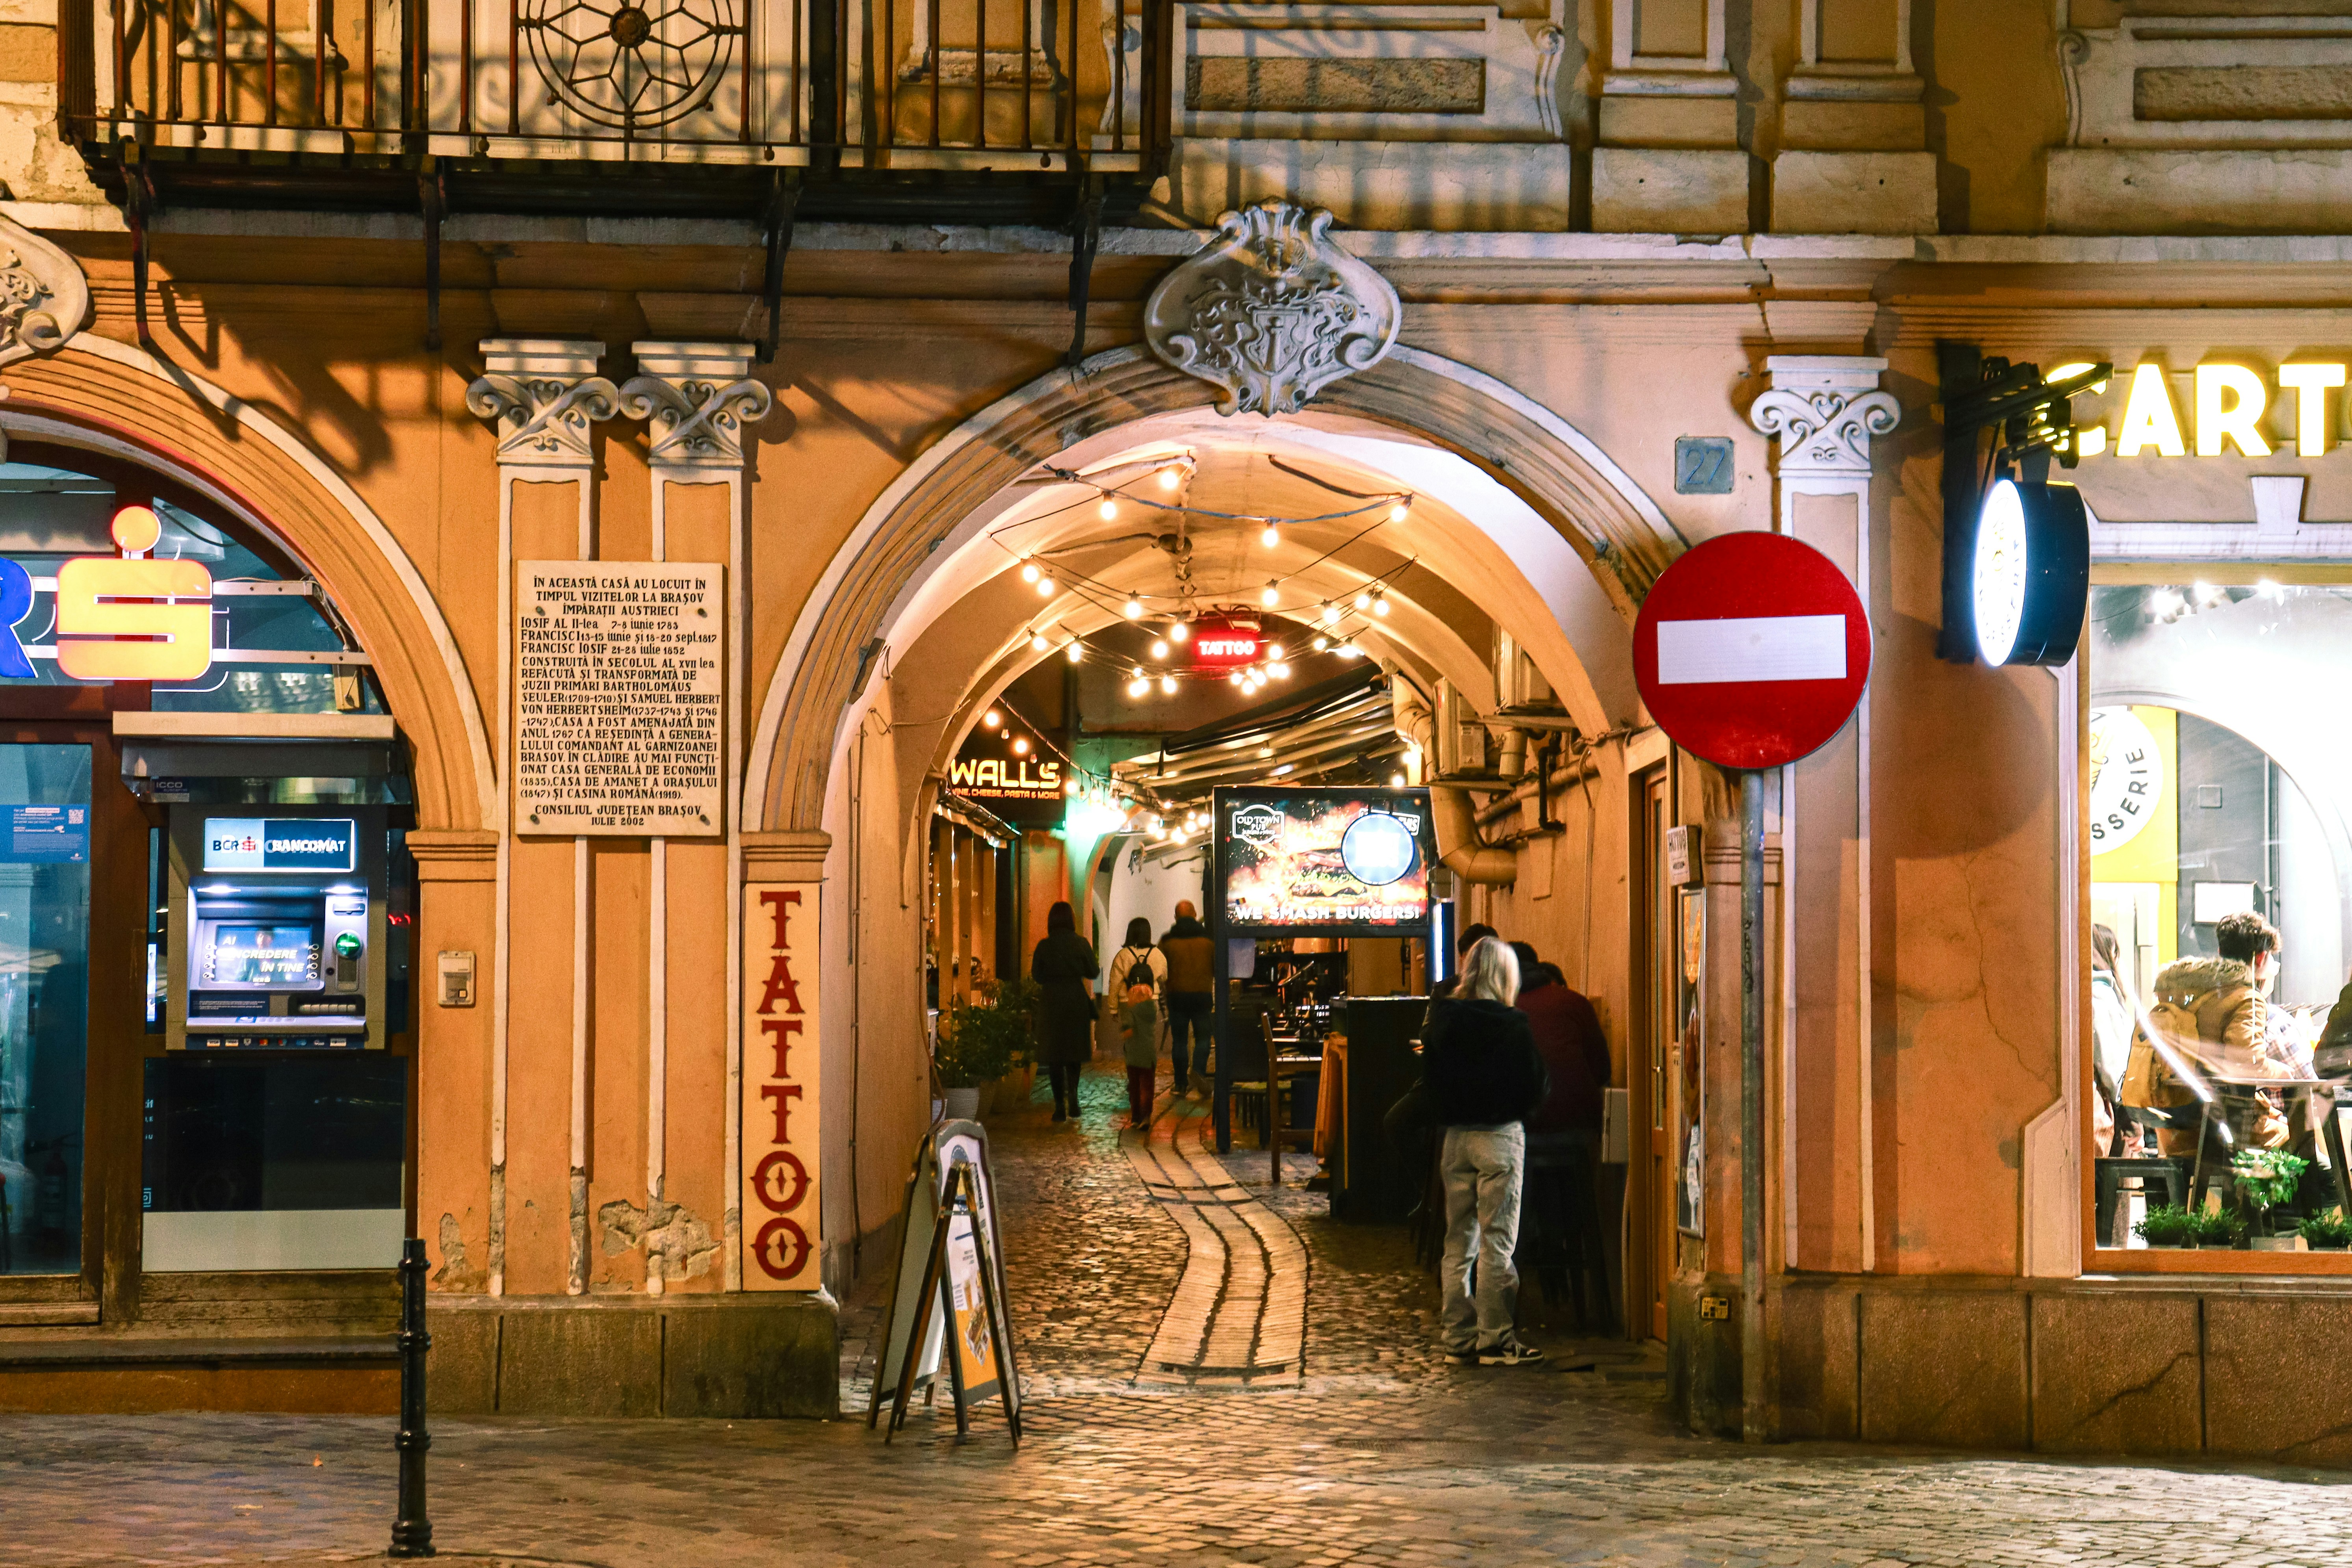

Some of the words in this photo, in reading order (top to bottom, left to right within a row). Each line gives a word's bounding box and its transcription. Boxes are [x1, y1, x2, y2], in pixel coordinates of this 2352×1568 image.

[1686, 446, 1725, 485] 27
[534, 575, 545, 588] ÎN
[634, 579, 648, 589] AU
[652, 579, 691, 590] LOCUIT
[695, 577, 706, 590] ÎN
[536, 591, 577, 601] TIMPUL
[581, 591, 639, 602] VIZITELOR
[642, 592, 657, 603] LA
[621, 605, 679, 616] AUSTRIECI
[521, 616, 549, 628] IOSIF
[553, 618, 568, 629] AL
[572, 618, 599, 629] II-lea
[611, 621, 627, 629] 7-8
[630, 618, 654, 630] iunie
[657, 621, 678, 630] 1783
[607, 630, 631, 642] iunie
[646, 634, 672, 645] 18-20
[579, 642, 607, 654] IOSIF
[611, 646, 636, 654] 21-28
[640, 643, 661, 655] iulie
[663, 646, 685, 655] 1852
[1199, 640, 1255, 655] TATTOO
[593, 655, 603, 667] ÎN
[607, 657, 657, 668] SECOLUL
[661, 658, 675, 669] AL
[699, 657, 715, 668] lea
[683, 670, 696, 680] DE
[522, 680, 550, 690] JUZII
[554, 681, 599, 691] PRIMARI
[631, 693, 672, 704] SAMUEL
[675, 694, 720, 704] HERBERT
[521, 704, 543, 714] VON
[696, 707, 717, 716] 1746
[587, 717, 594, 727] A
[598, 717, 626, 727] FOST
[697, 718, 715, 728] DIN
[521, 728, 549, 739] ANUL
[552, 729, 573, 739] 1767
[577, 729, 591, 739] CA
[659, 729, 665, 740] A
[521, 740, 553, 750] LULUI
[557, 740, 624, 751] COMANDANT
[627, 741, 641, 752] AL
[645, 741, 717, 752] GARNIZOANEI
[568, 751, 579, 763] ÎN
[633, 753, 648, 763] AU
[651, 753, 671, 763] MAI
[521, 764, 547, 774] ONAT
[551, 765, 580, 774] CASA
[646, 765, 659, 775] DE
[663, 765, 716, 776] ECONOMII
[585, 776, 599, 787] DE
[603, 777, 648, 787] AMANET
[652, 777, 659, 787] A
[520, 789, 550, 799] (1847)
[567, 789, 606, 799] CASINA
[971, 788, 1004, 798] CHEESE,
[1004, 790, 1030, 798] PASTA
[1038, 791, 1060, 800] MORE
[535, 805, 592, 815] CONSILIUL
[591, 817, 616, 826] IULIE
[621, 817, 644, 826] 2002
[1236, 816, 1254, 826] OLD
[1254, 815, 1280, 824] TOWN
[272, 839, 346, 852] BANCOMAT
[1235, 906, 1263, 920] WE
[1269, 906, 1330, 920] SMASH
[1336, 906, 1420, 920] BURGERS!
[222, 936, 237, 945] AI
[261, 961, 274, 972] ÎN
[277, 963, 305, 972] TINE
[750, 891, 813, 1281] TATTOO
